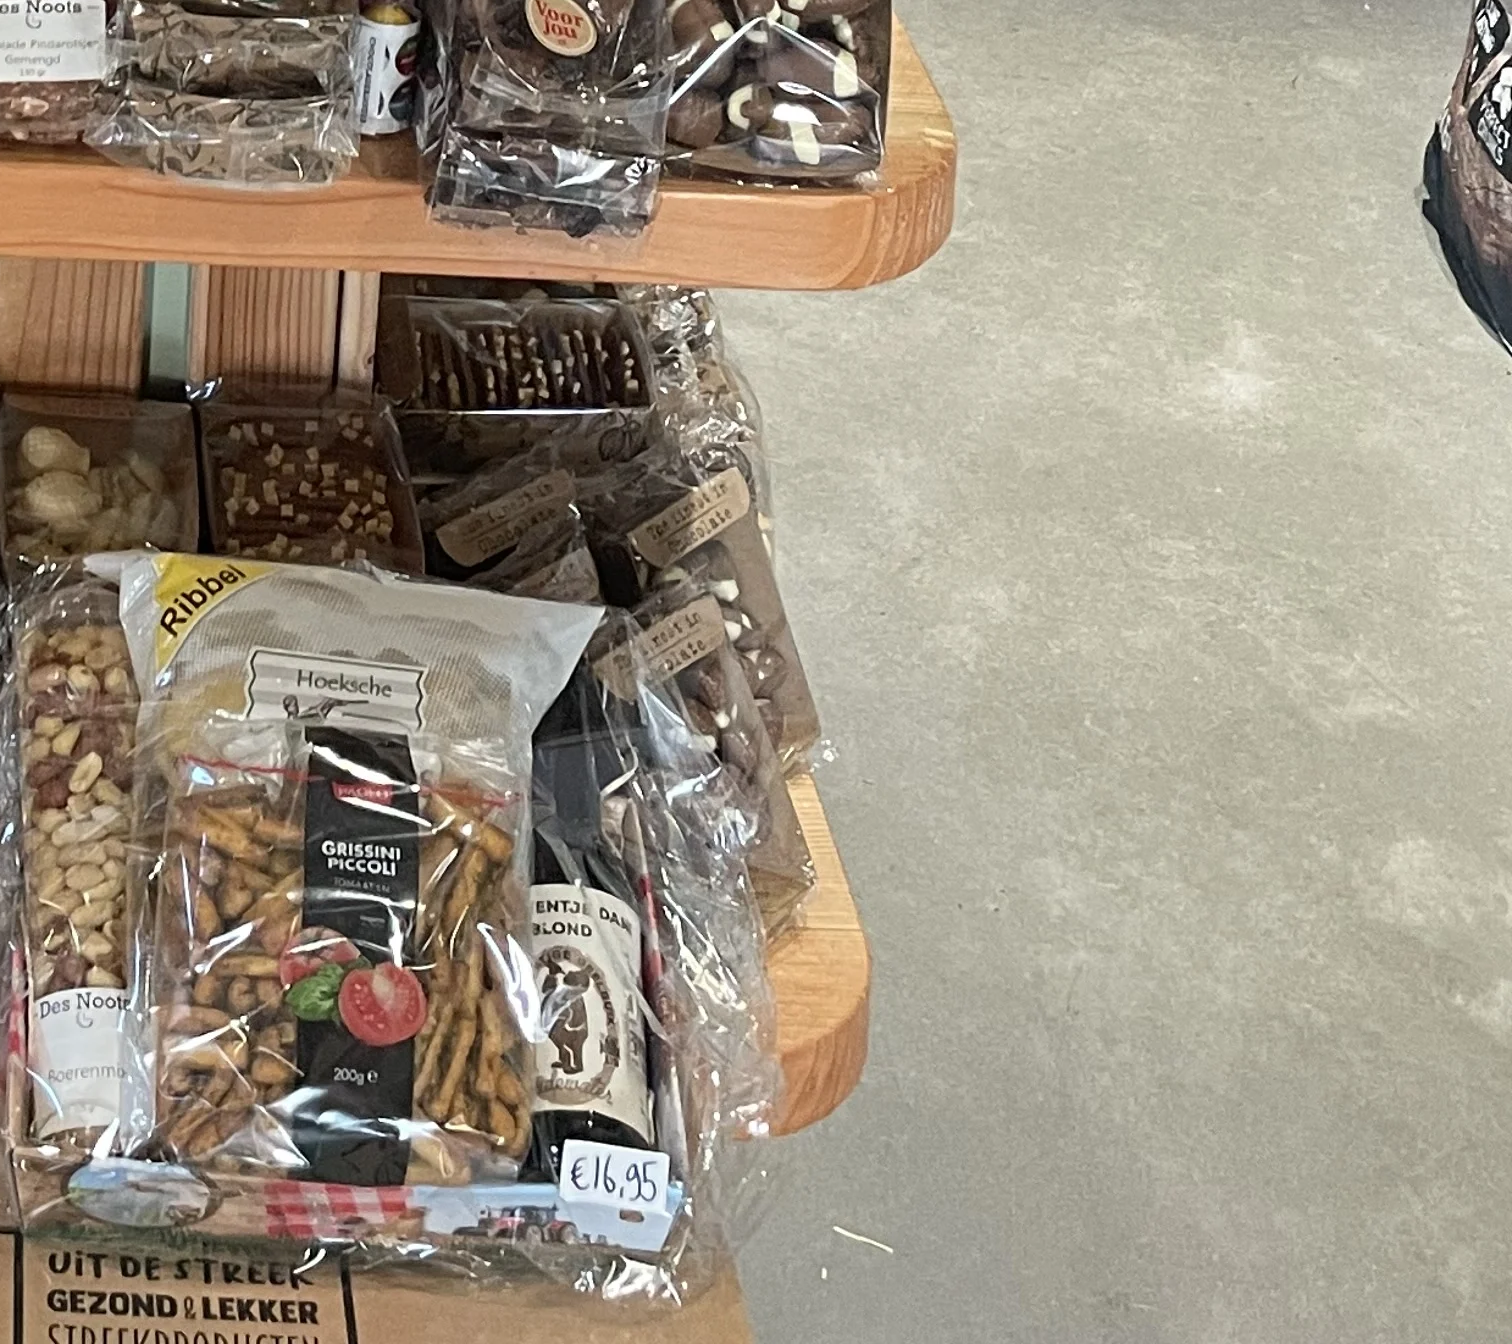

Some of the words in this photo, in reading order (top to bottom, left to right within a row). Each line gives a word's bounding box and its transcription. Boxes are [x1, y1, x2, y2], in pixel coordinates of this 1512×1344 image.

[160, 564, 247, 638] Ribbel
[297, 669, 393, 698] Hoeksche
[321, 839, 402, 863] GRISSINI
[327, 856, 397, 877] PICCOLI
[40, 998, 70, 1020] Des
[333, 1067, 366, 1085] 200g
[120, 1253, 160, 1281] DE
[47, 1288, 178, 1318] GEZOND
[201, 1296, 319, 1325] LEKKER
